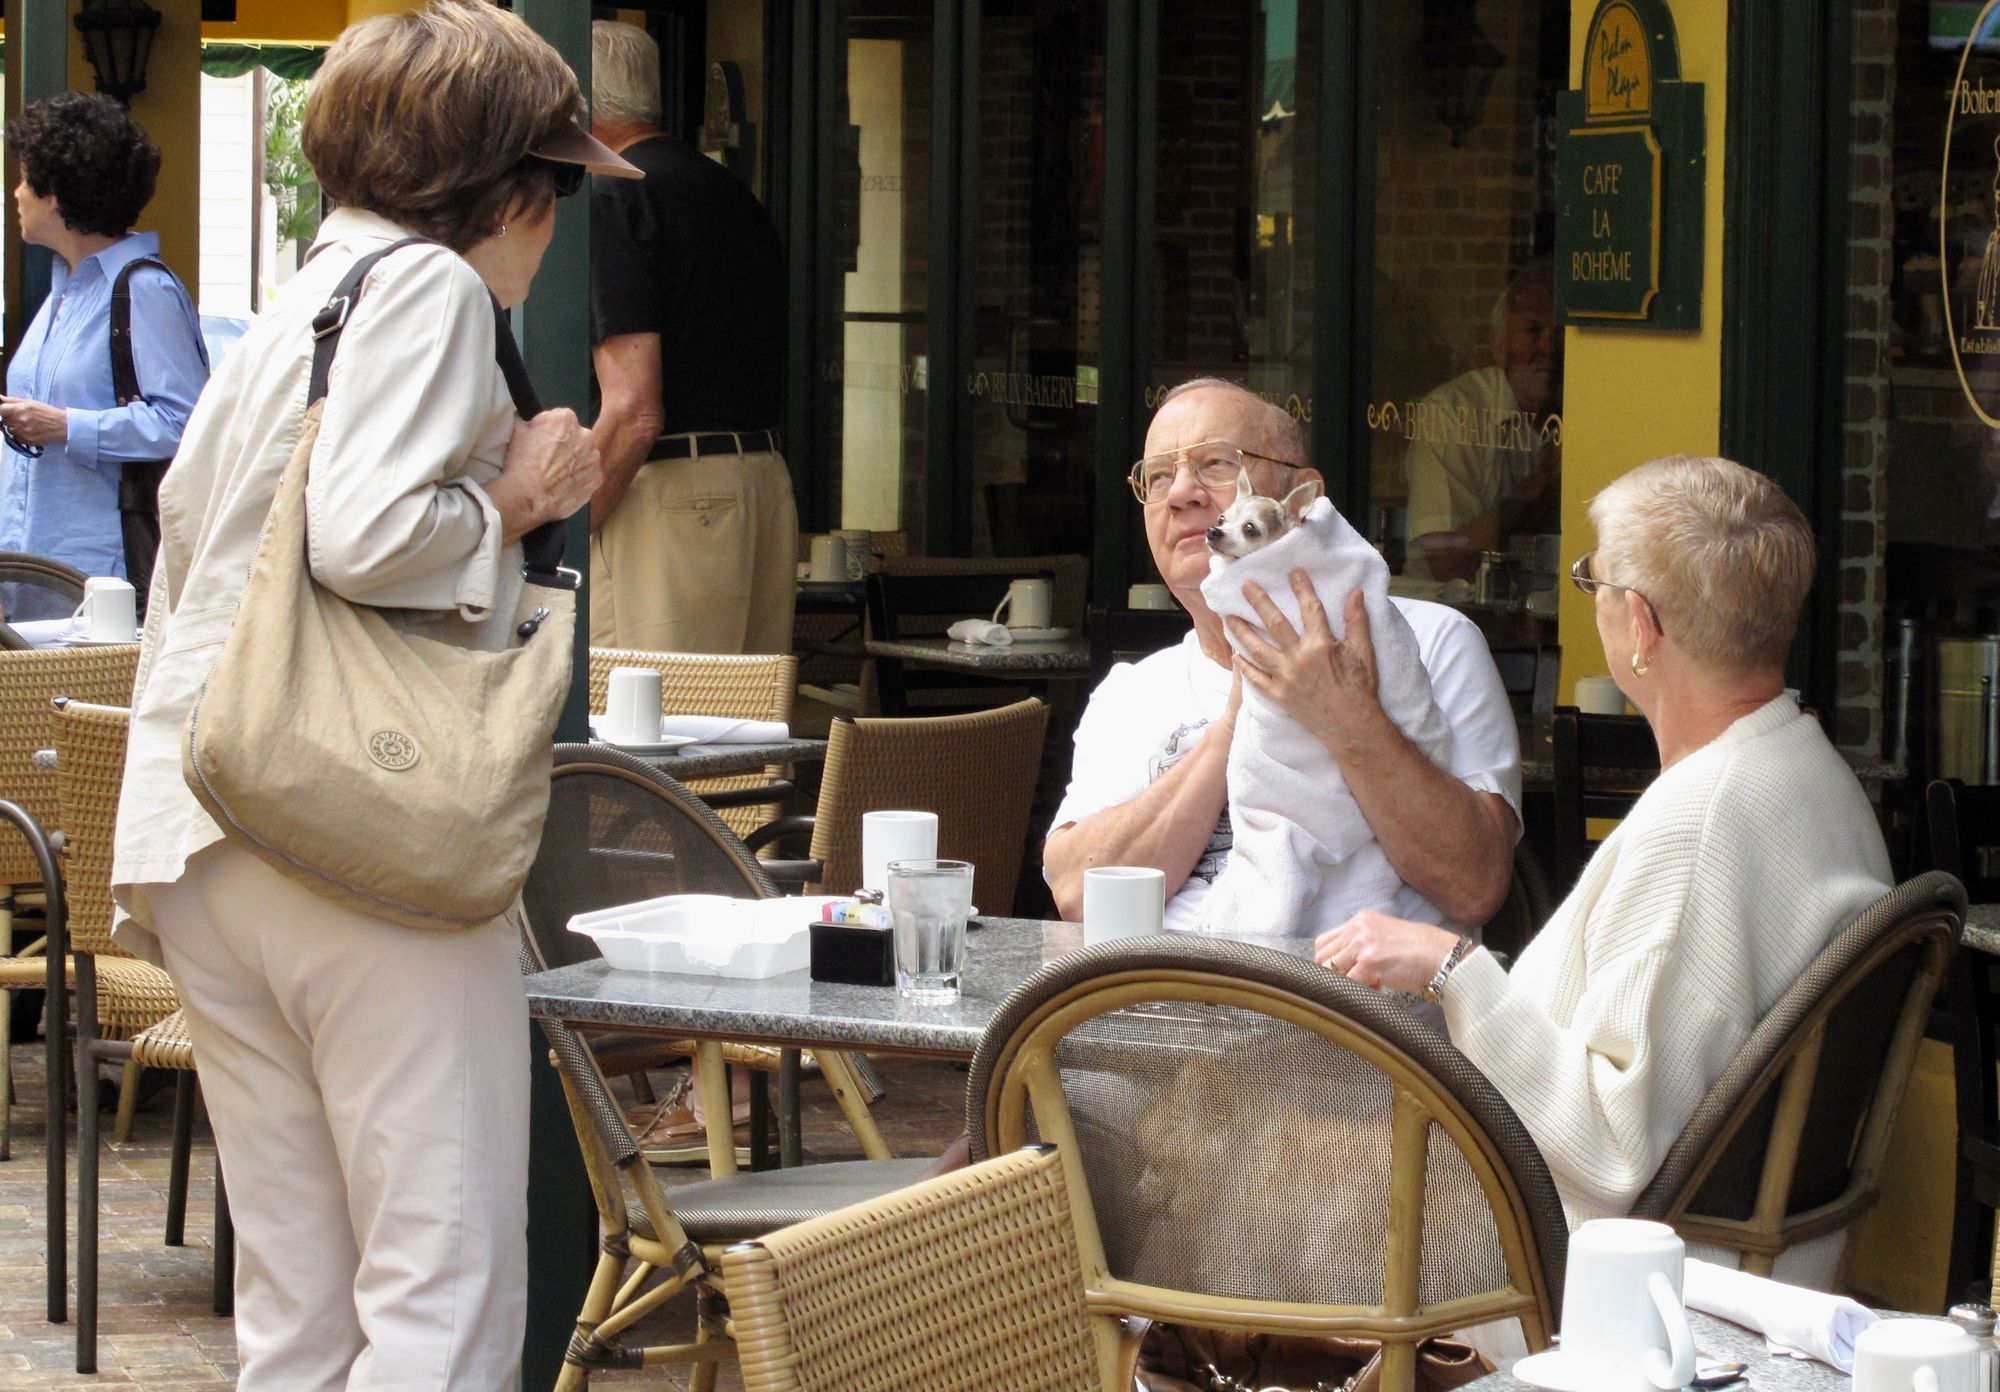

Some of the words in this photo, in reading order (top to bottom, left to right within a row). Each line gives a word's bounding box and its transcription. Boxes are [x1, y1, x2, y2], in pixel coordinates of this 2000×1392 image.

[1593, 208, 1612, 239] LA
[1024, 374, 1075, 409] BAKERY
[1456, 406, 1537, 452] BAKERY
